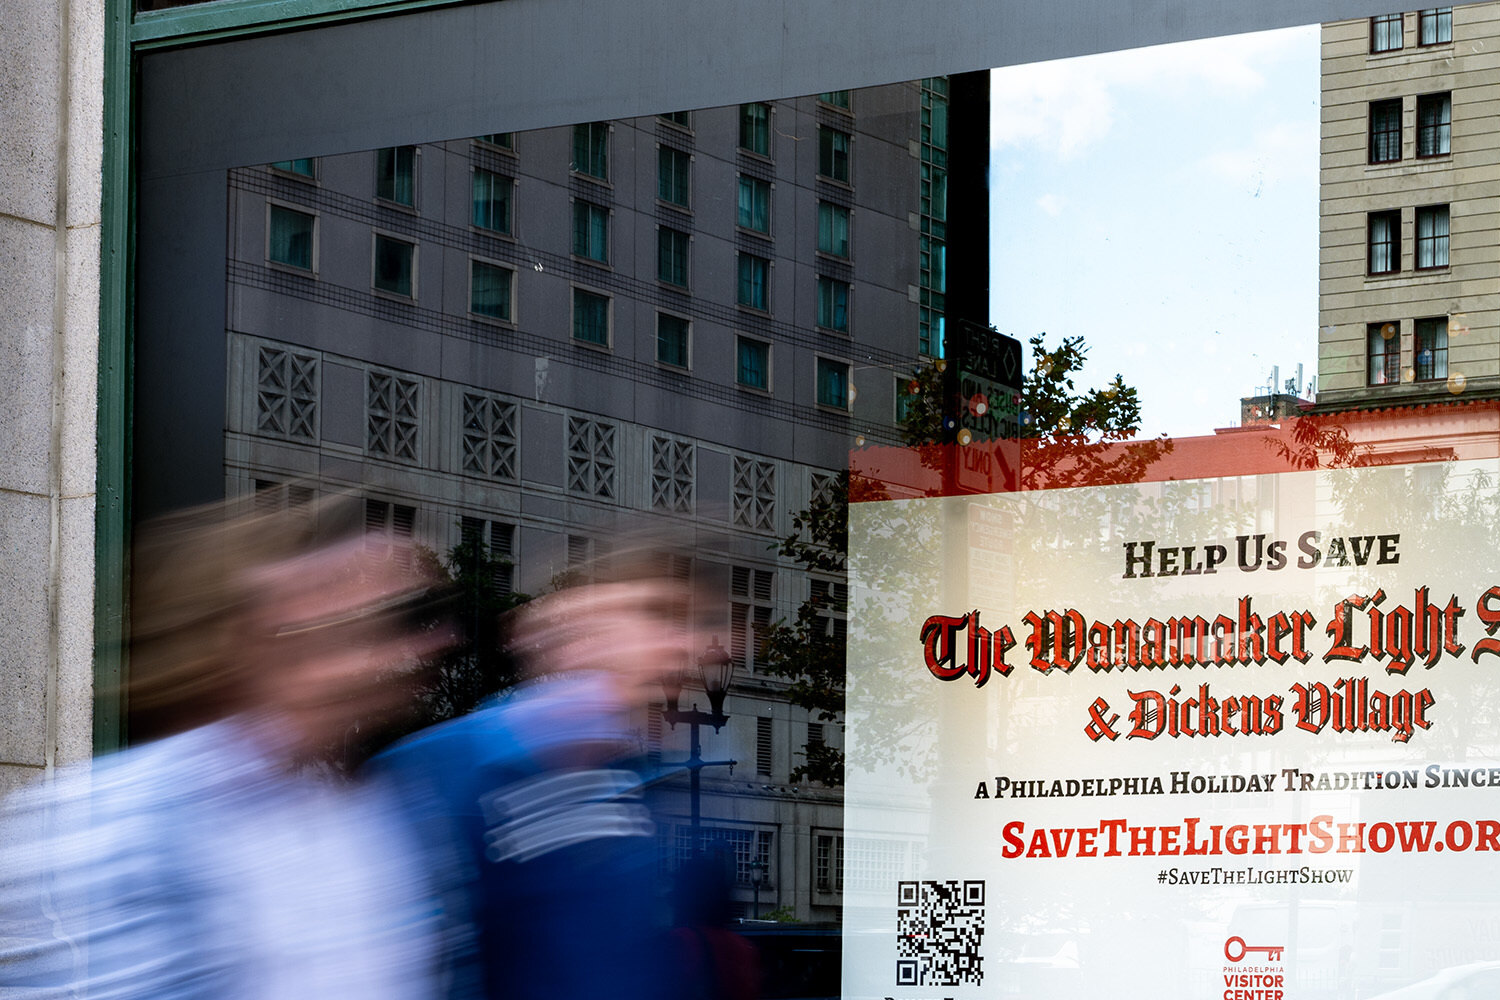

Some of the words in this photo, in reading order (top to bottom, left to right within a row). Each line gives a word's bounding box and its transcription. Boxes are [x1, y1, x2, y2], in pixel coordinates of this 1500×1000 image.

[920, 609, 1017, 689] The
[1022, 595, 1317, 677] Wanamaker
[1322, 585, 1466, 676] Light
[1083, 696, 1120, 742] &
[1126, 682, 1284, 741] Dickens
[1289, 676, 1435, 743] Village
[1223, 974, 1284, 988] VISITOR
